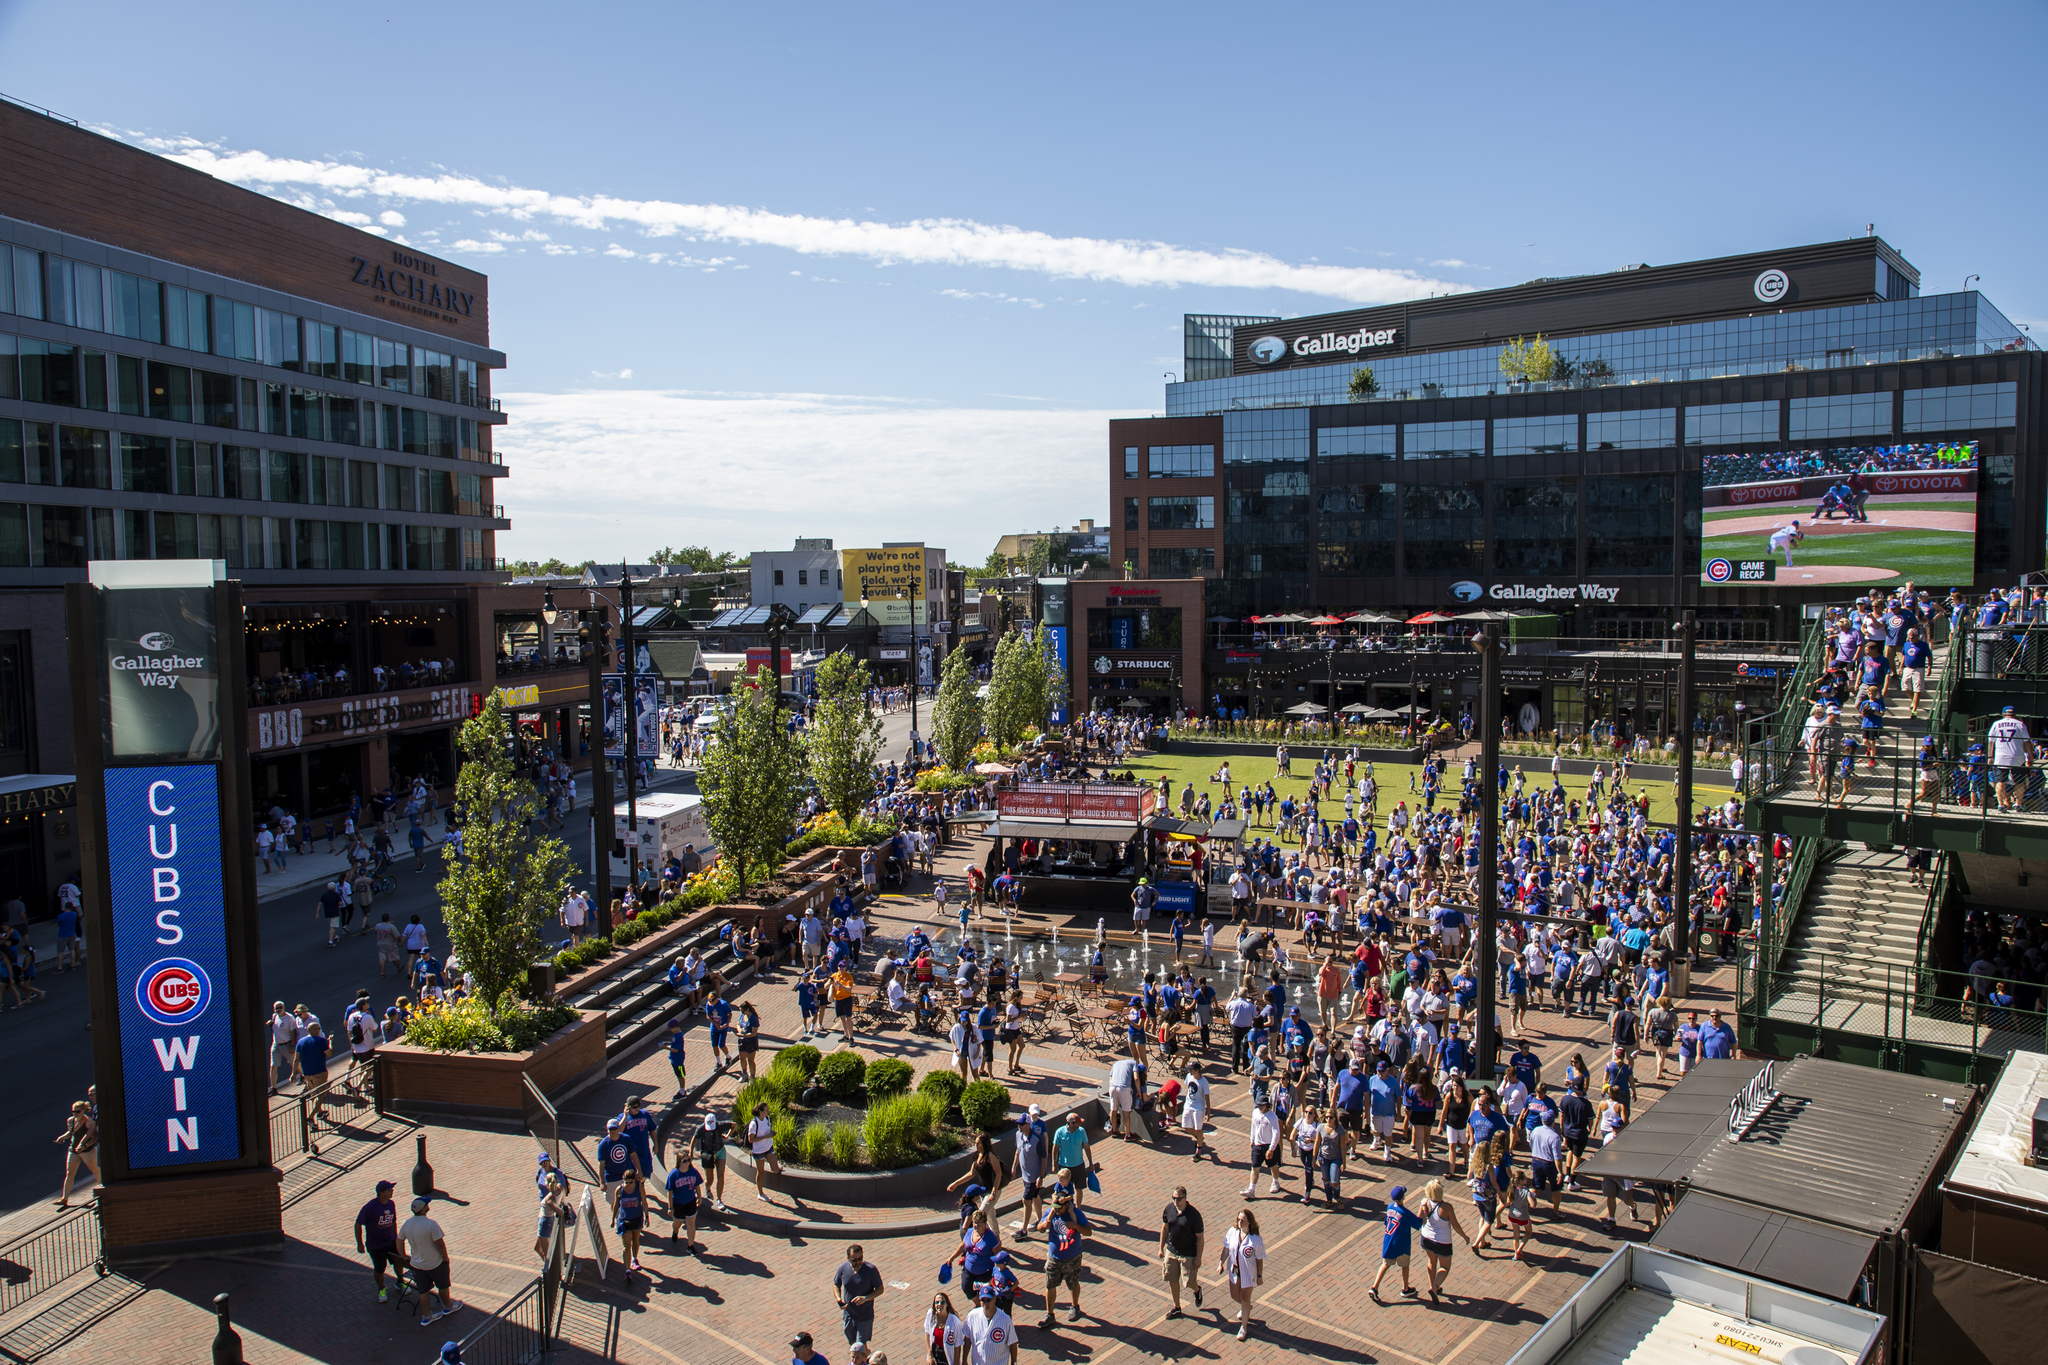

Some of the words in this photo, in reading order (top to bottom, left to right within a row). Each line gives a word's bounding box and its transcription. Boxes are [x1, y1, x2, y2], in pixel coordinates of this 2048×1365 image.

[394, 250, 439, 277] HOTEL
[352, 256, 476, 317] ZACHARY
[390, 298, 440, 319] GALLAGHER
[443, 314, 459, 324] WAY
[1293, 328, 1396, 356] Gallagher
[1901, 476, 1963, 490] TOYOTA
[1751, 484, 1798, 500] TOYOTA
[866, 551, 898, 561] We're
[901, 551, 920, 560] not
[858, 563, 900, 575] playing
[902, 563, 921, 572] the
[1741, 561, 1765, 572] GAME
[861, 576, 888, 587] field,
[891, 576, 922, 585] we'e
[1739, 570, 1765, 580] RECAP
[866, 587, 908, 597] evelig
[1108, 585, 1160, 596] Budweiser
[1489, 584, 1578, 603] Gallagher
[1578, 584, 1620, 603] Way
[111, 655, 204, 672] Gallagher
[138, 672, 179, 689] Way
[258, 708, 303, 749] BBQ
[1999, 729, 2017, 742] 17
[0, 785, 74, 813] HARY
[1002, 806, 1016, 814] THIS
[1017, 807, 1035, 815] BUD'S
[1072, 809, 1086, 817] THIS
[1087, 810, 1105, 818] BUD'S
[670, 821, 690, 835] CHICAGO
[149, 780, 184, 945] CUBS
[152, 1035, 200, 1152] WIN
[675, 1176, 697, 1188] CHICAGO
[1385, 1218, 1400, 1236] 17
[1715, 1334, 1762, 1355] REAR
